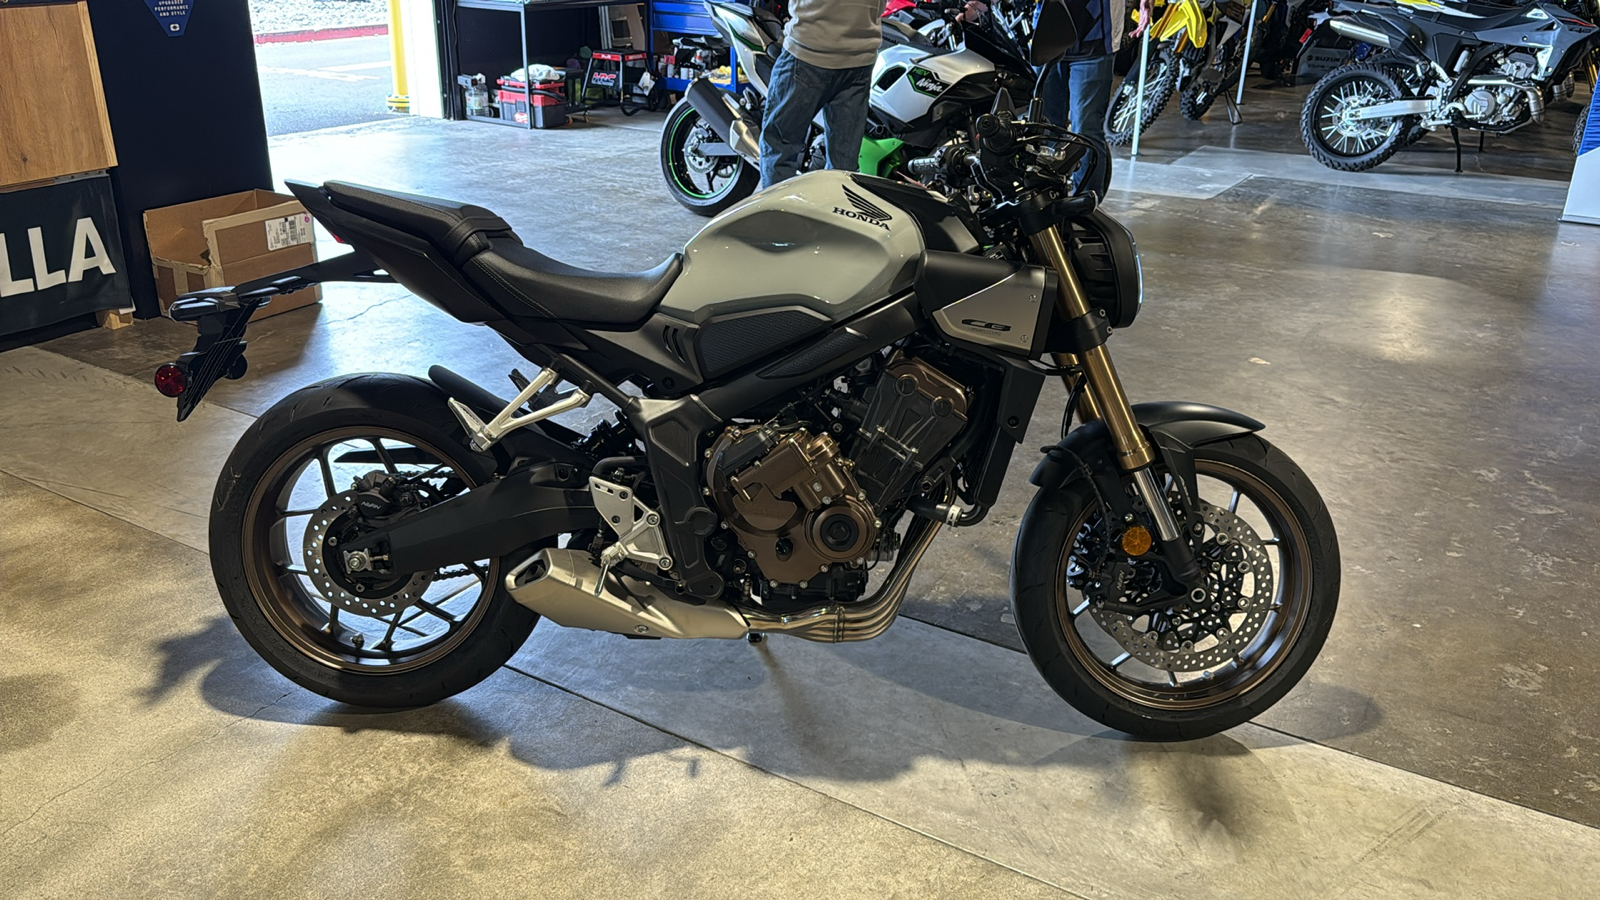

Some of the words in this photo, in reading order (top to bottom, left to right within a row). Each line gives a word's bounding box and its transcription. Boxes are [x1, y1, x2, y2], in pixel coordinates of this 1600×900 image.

[154, 4, 189, 12] PERFORMANCE
[912, 67, 930, 76] HEV
[916, 77, 943, 92] Ninja
[832, 206, 891, 231] HONDA
